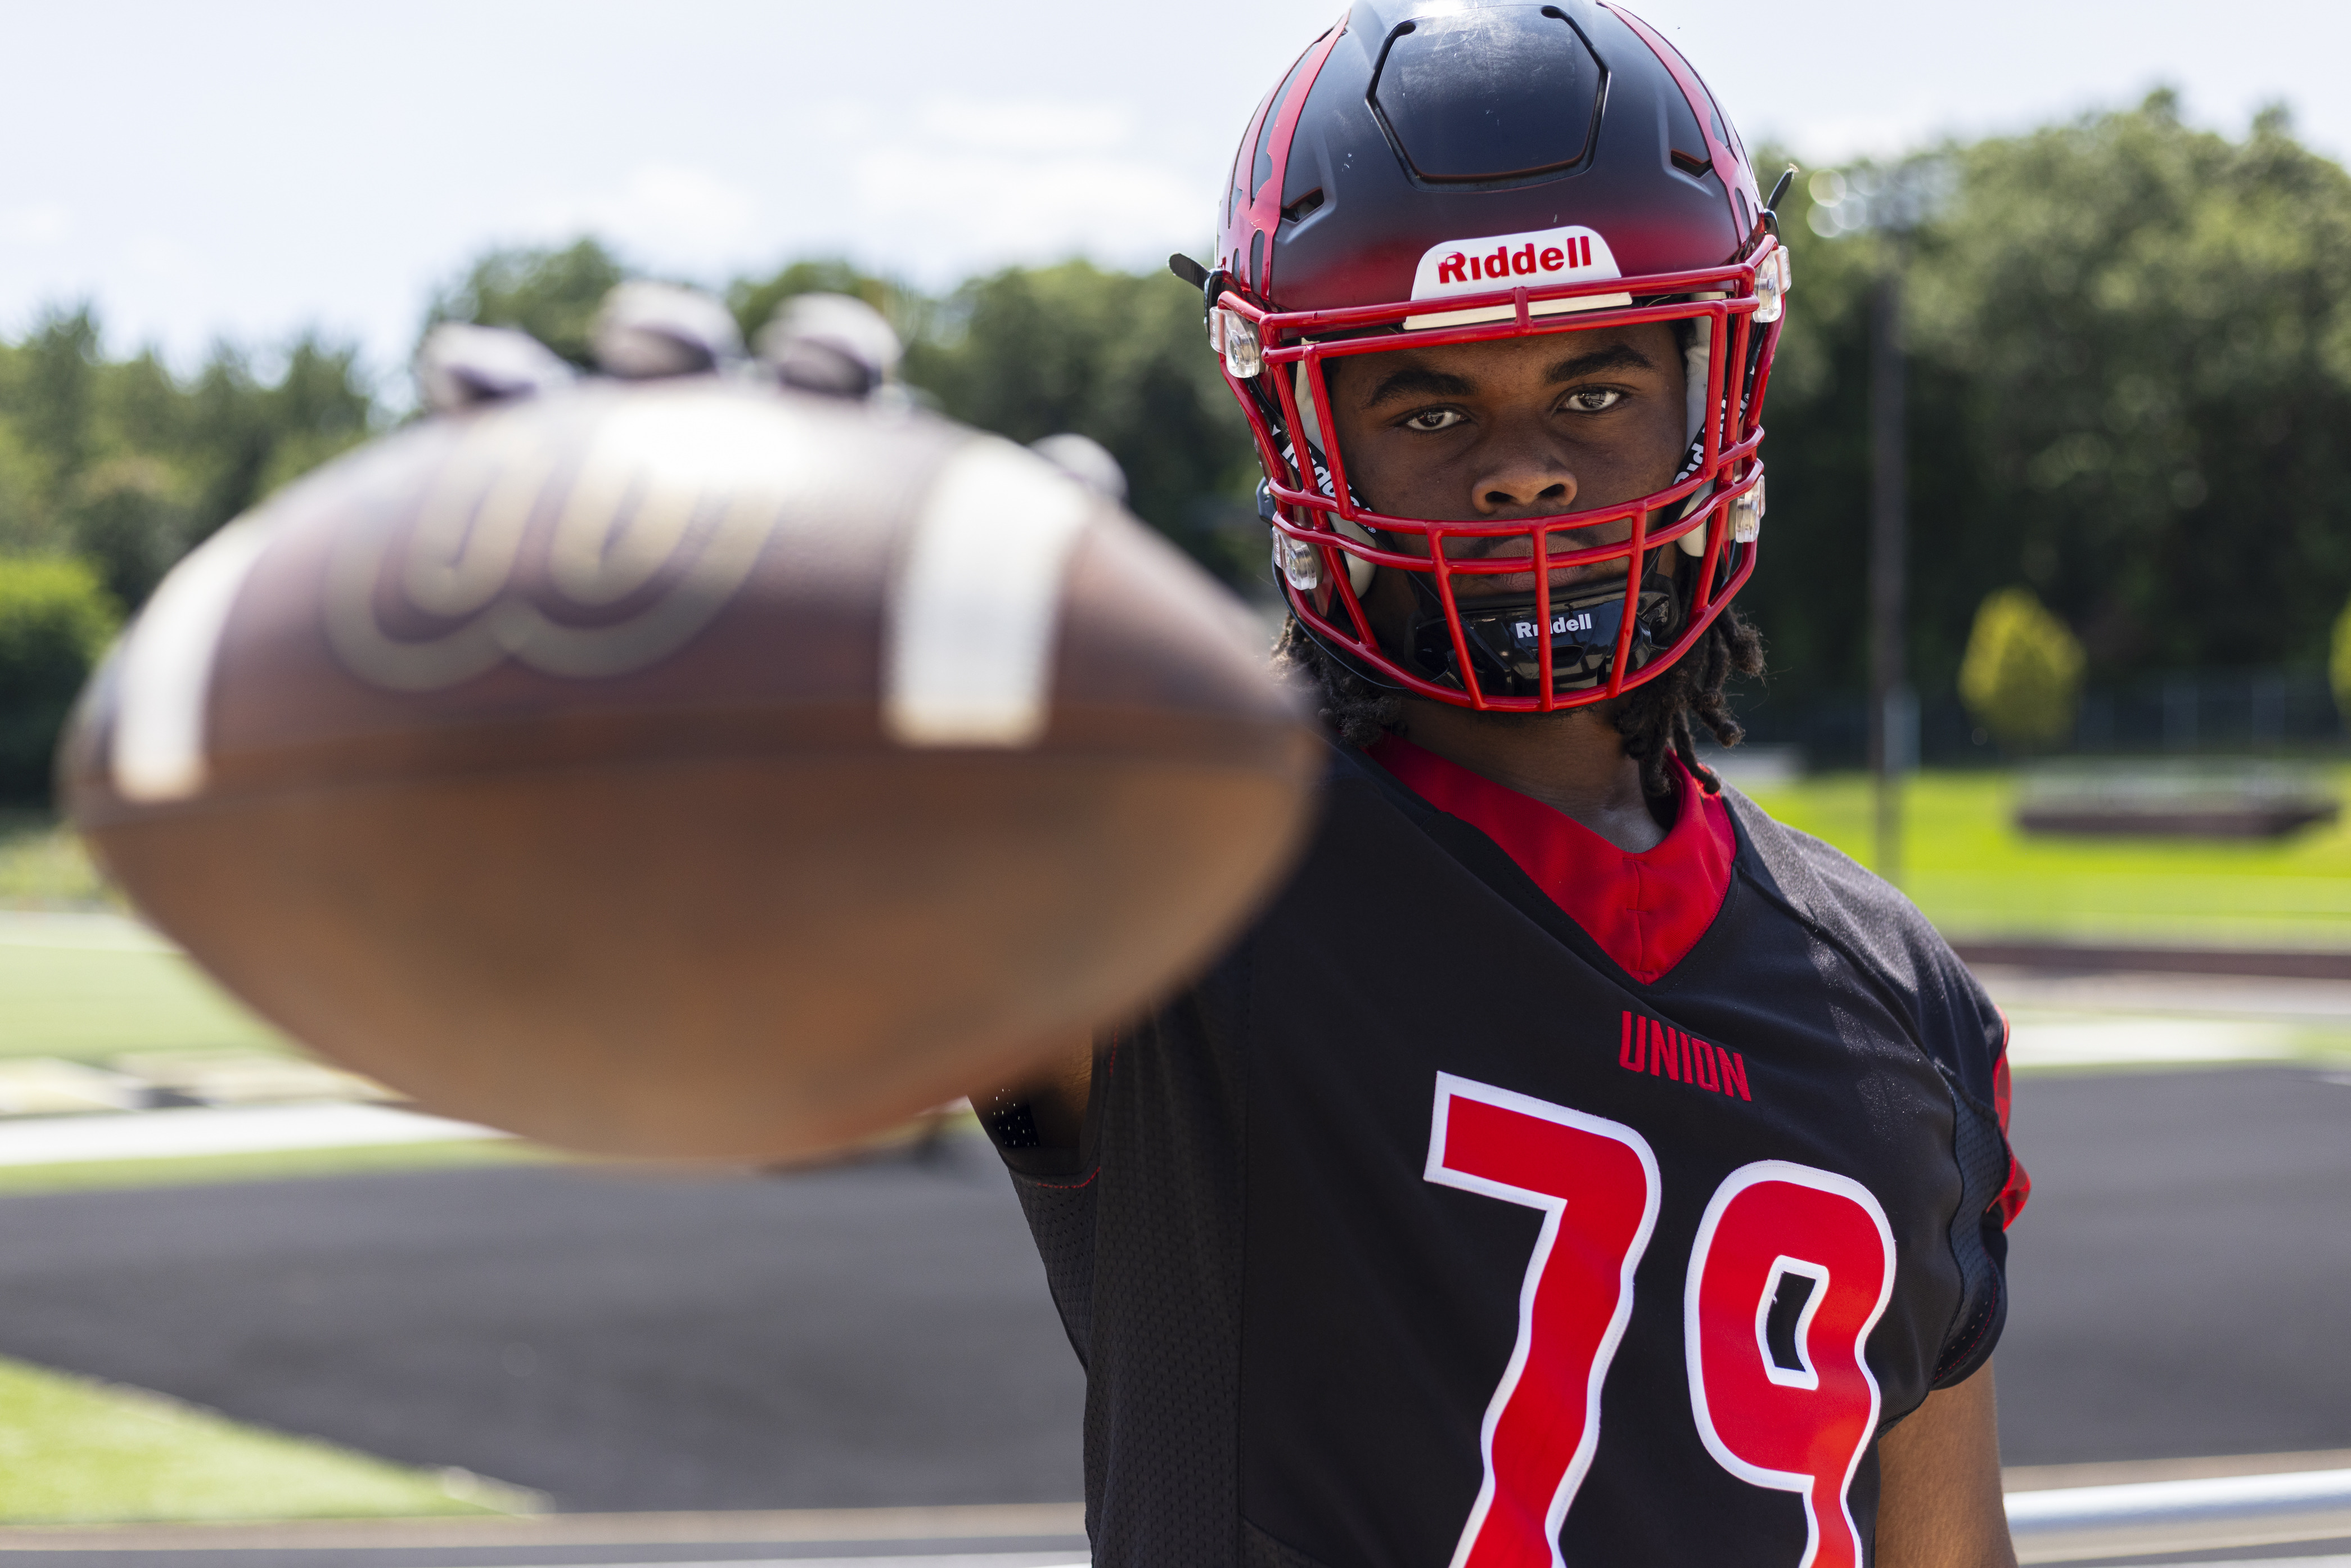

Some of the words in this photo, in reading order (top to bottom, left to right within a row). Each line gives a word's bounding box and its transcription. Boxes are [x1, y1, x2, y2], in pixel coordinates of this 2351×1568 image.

[1437, 236, 1591, 283] Riddell
[1515, 613, 1592, 638] Ridell
[1619, 1011, 1751, 1101] UNION
[1424, 1071, 1897, 1568] 79
